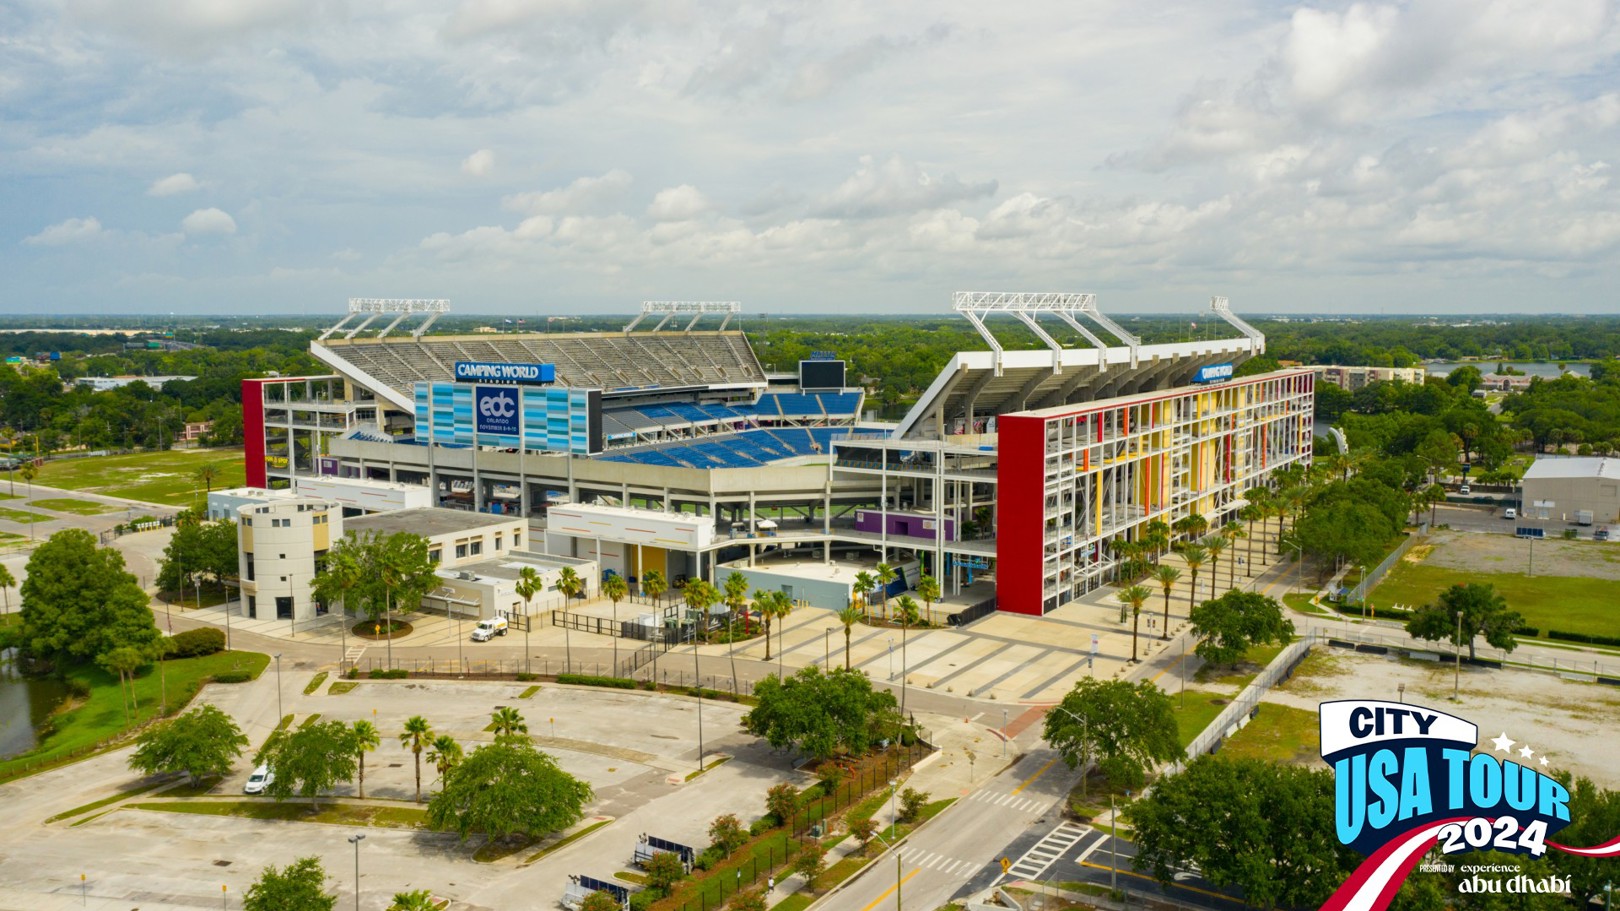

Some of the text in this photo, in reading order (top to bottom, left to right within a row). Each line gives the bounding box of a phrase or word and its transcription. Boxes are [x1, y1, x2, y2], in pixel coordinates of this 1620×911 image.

[457, 364, 539, 378] CAMPING WORLD
[480, 391, 515, 417] edc
